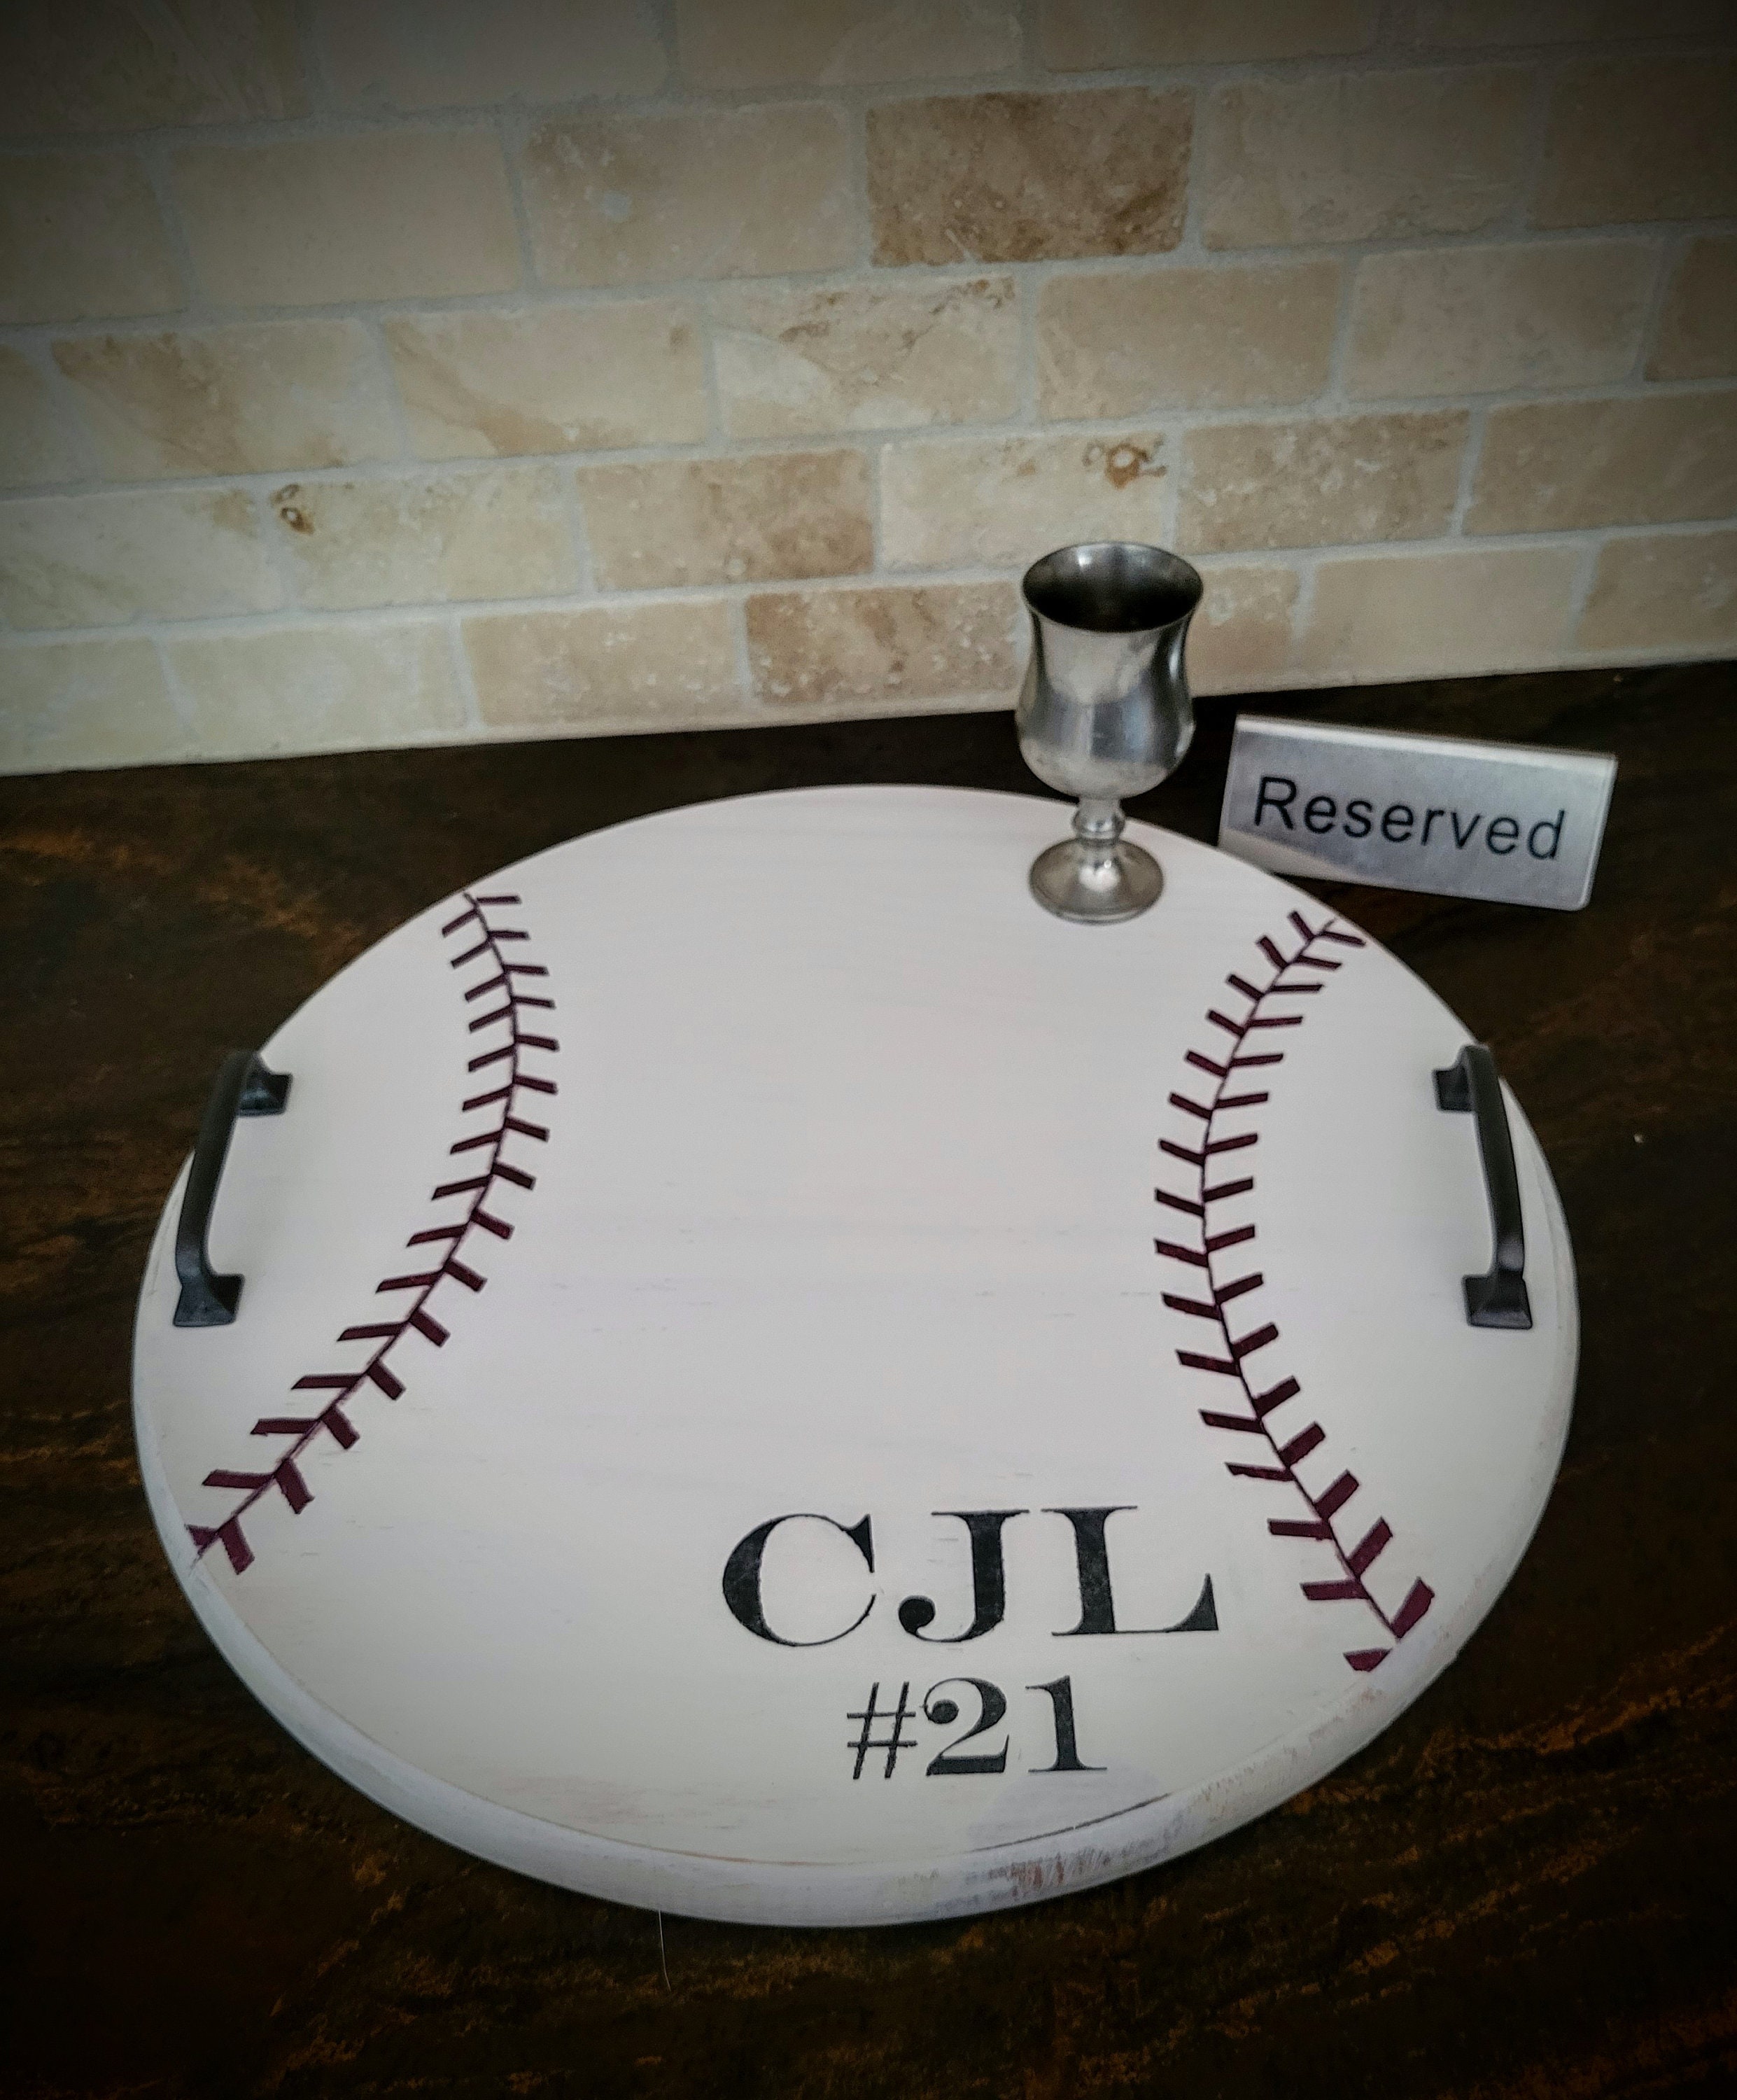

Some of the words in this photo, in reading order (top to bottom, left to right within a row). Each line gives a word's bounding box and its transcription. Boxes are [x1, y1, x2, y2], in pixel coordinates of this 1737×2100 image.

[1253, 775, 1566, 860] Reserved
[722, 1506, 1220, 1647] CJL
[846, 1676, 1108, 1780] #21
